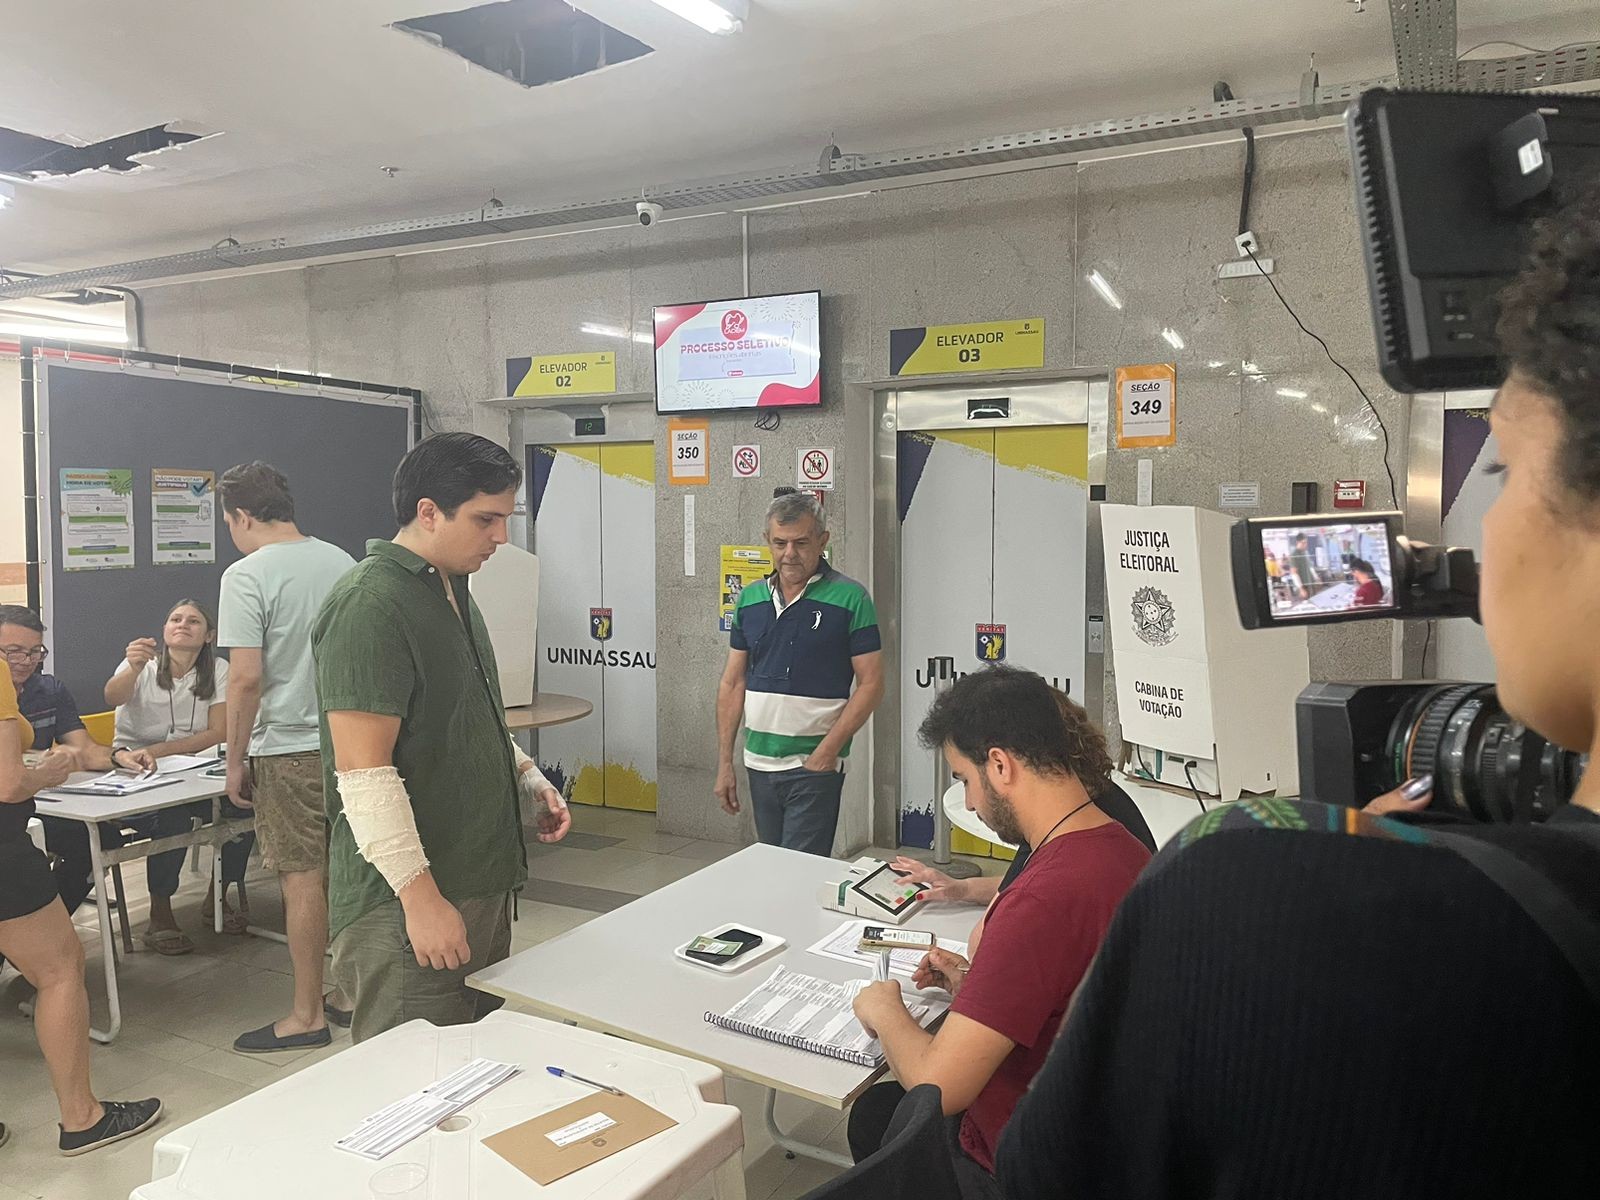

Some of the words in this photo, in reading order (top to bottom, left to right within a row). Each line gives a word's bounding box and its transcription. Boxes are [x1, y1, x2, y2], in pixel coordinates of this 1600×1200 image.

[680, 341, 735, 354] PROCESSO
[737, 336, 789, 350] SELETIVO
[936, 332, 1004, 347] ELEVADOR
[958, 348, 981, 362] 03
[539, 362, 588, 374] ELEVADOR
[555, 375, 572, 387] 02
[1130, 399, 1162, 415] 349
[677, 446, 699, 459] 350
[1124, 530, 1170, 552] JUSTIÇA
[1120, 552, 1179, 573] ELEITORAL
[547, 647, 656, 669] UNINASSAU
[1135, 681, 1168, 699] CABINA
[1170, 687, 1184, 701] DE
[1139, 699, 1182, 719] VOTAÇÃO
